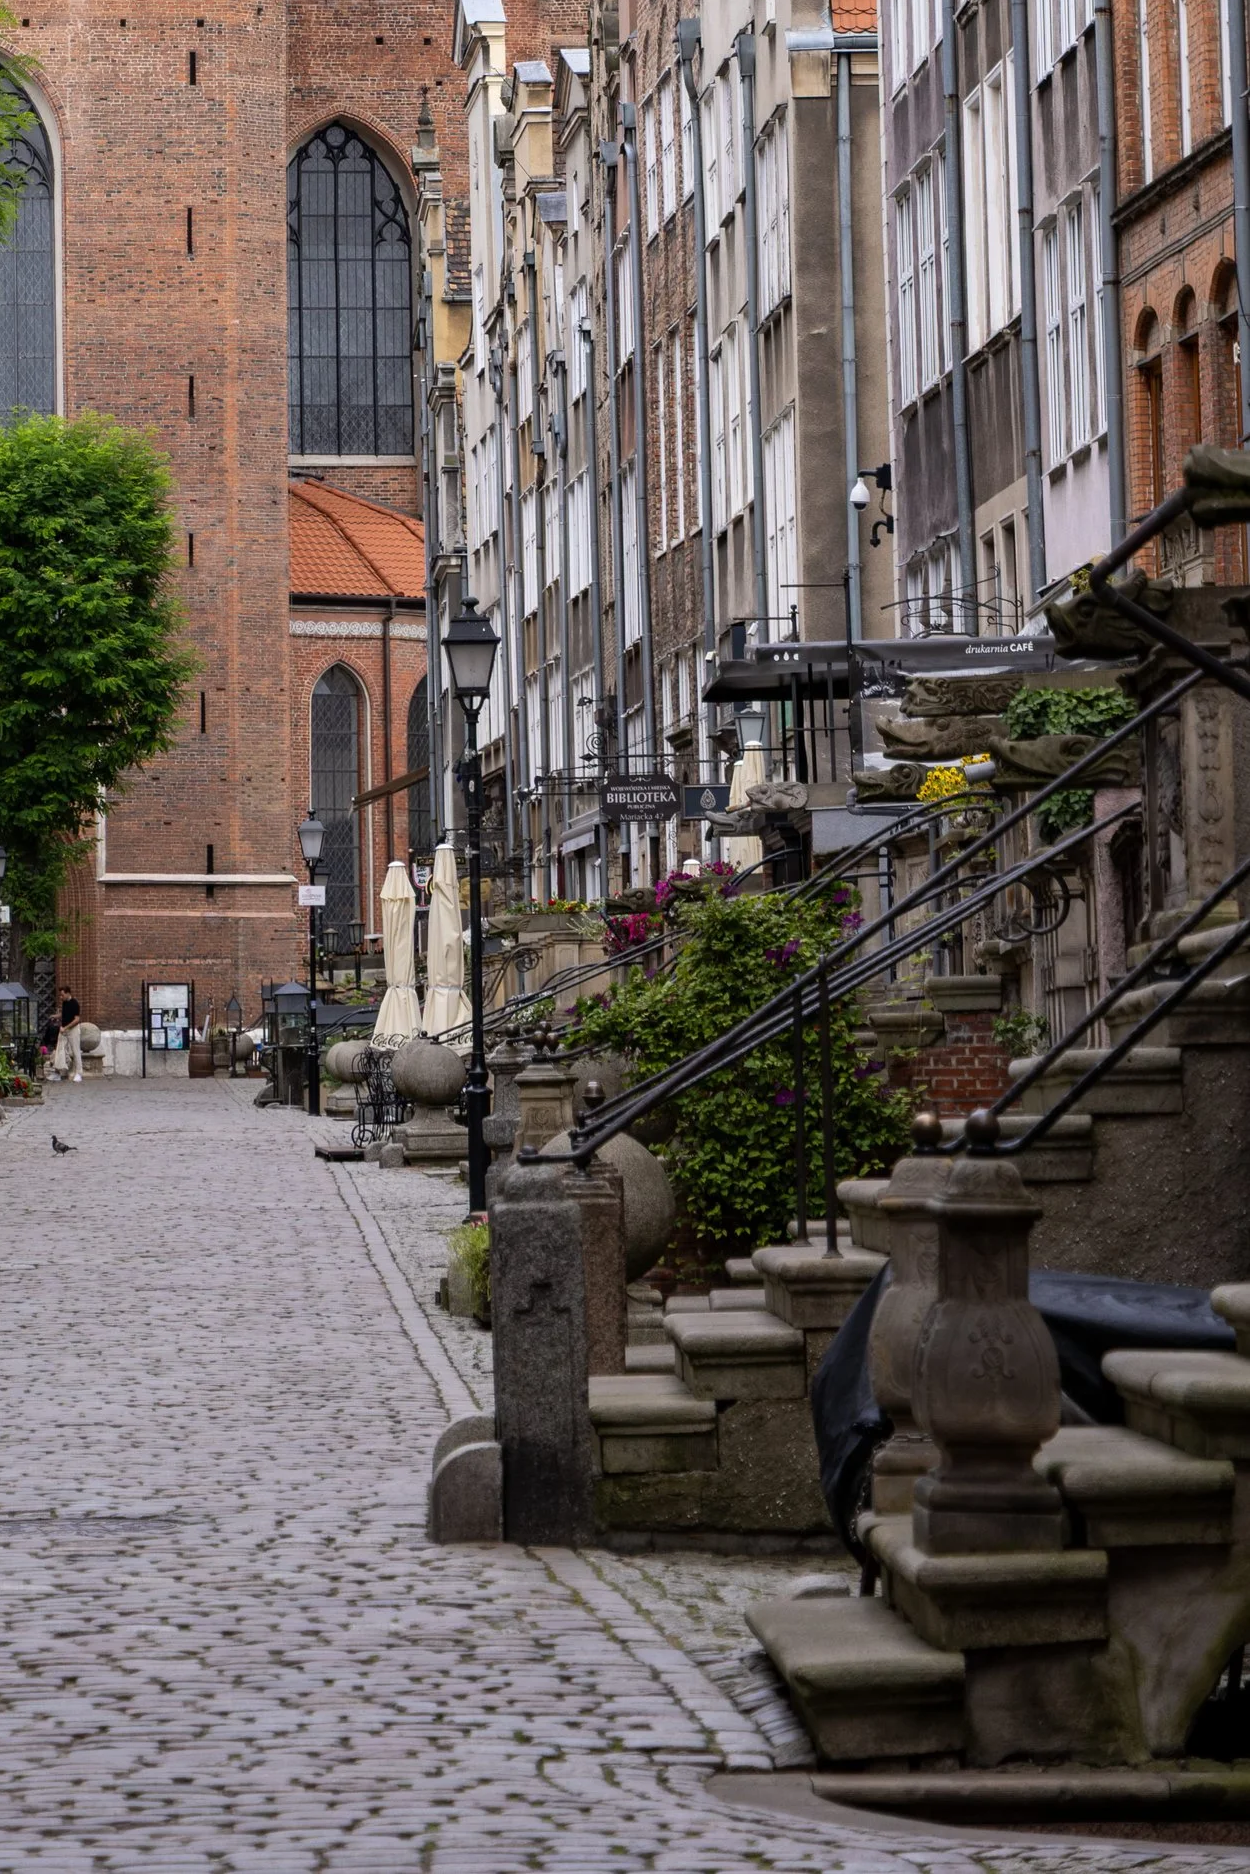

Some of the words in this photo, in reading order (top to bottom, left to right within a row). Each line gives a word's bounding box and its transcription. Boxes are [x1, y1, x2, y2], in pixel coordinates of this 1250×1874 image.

[965, 644, 1008, 654] drukarnia
[1010, 641, 1034, 652] CAFÉ
[607, 792, 676, 803] BIBLIOTEKA
[619, 813, 653, 821] Mariacka
